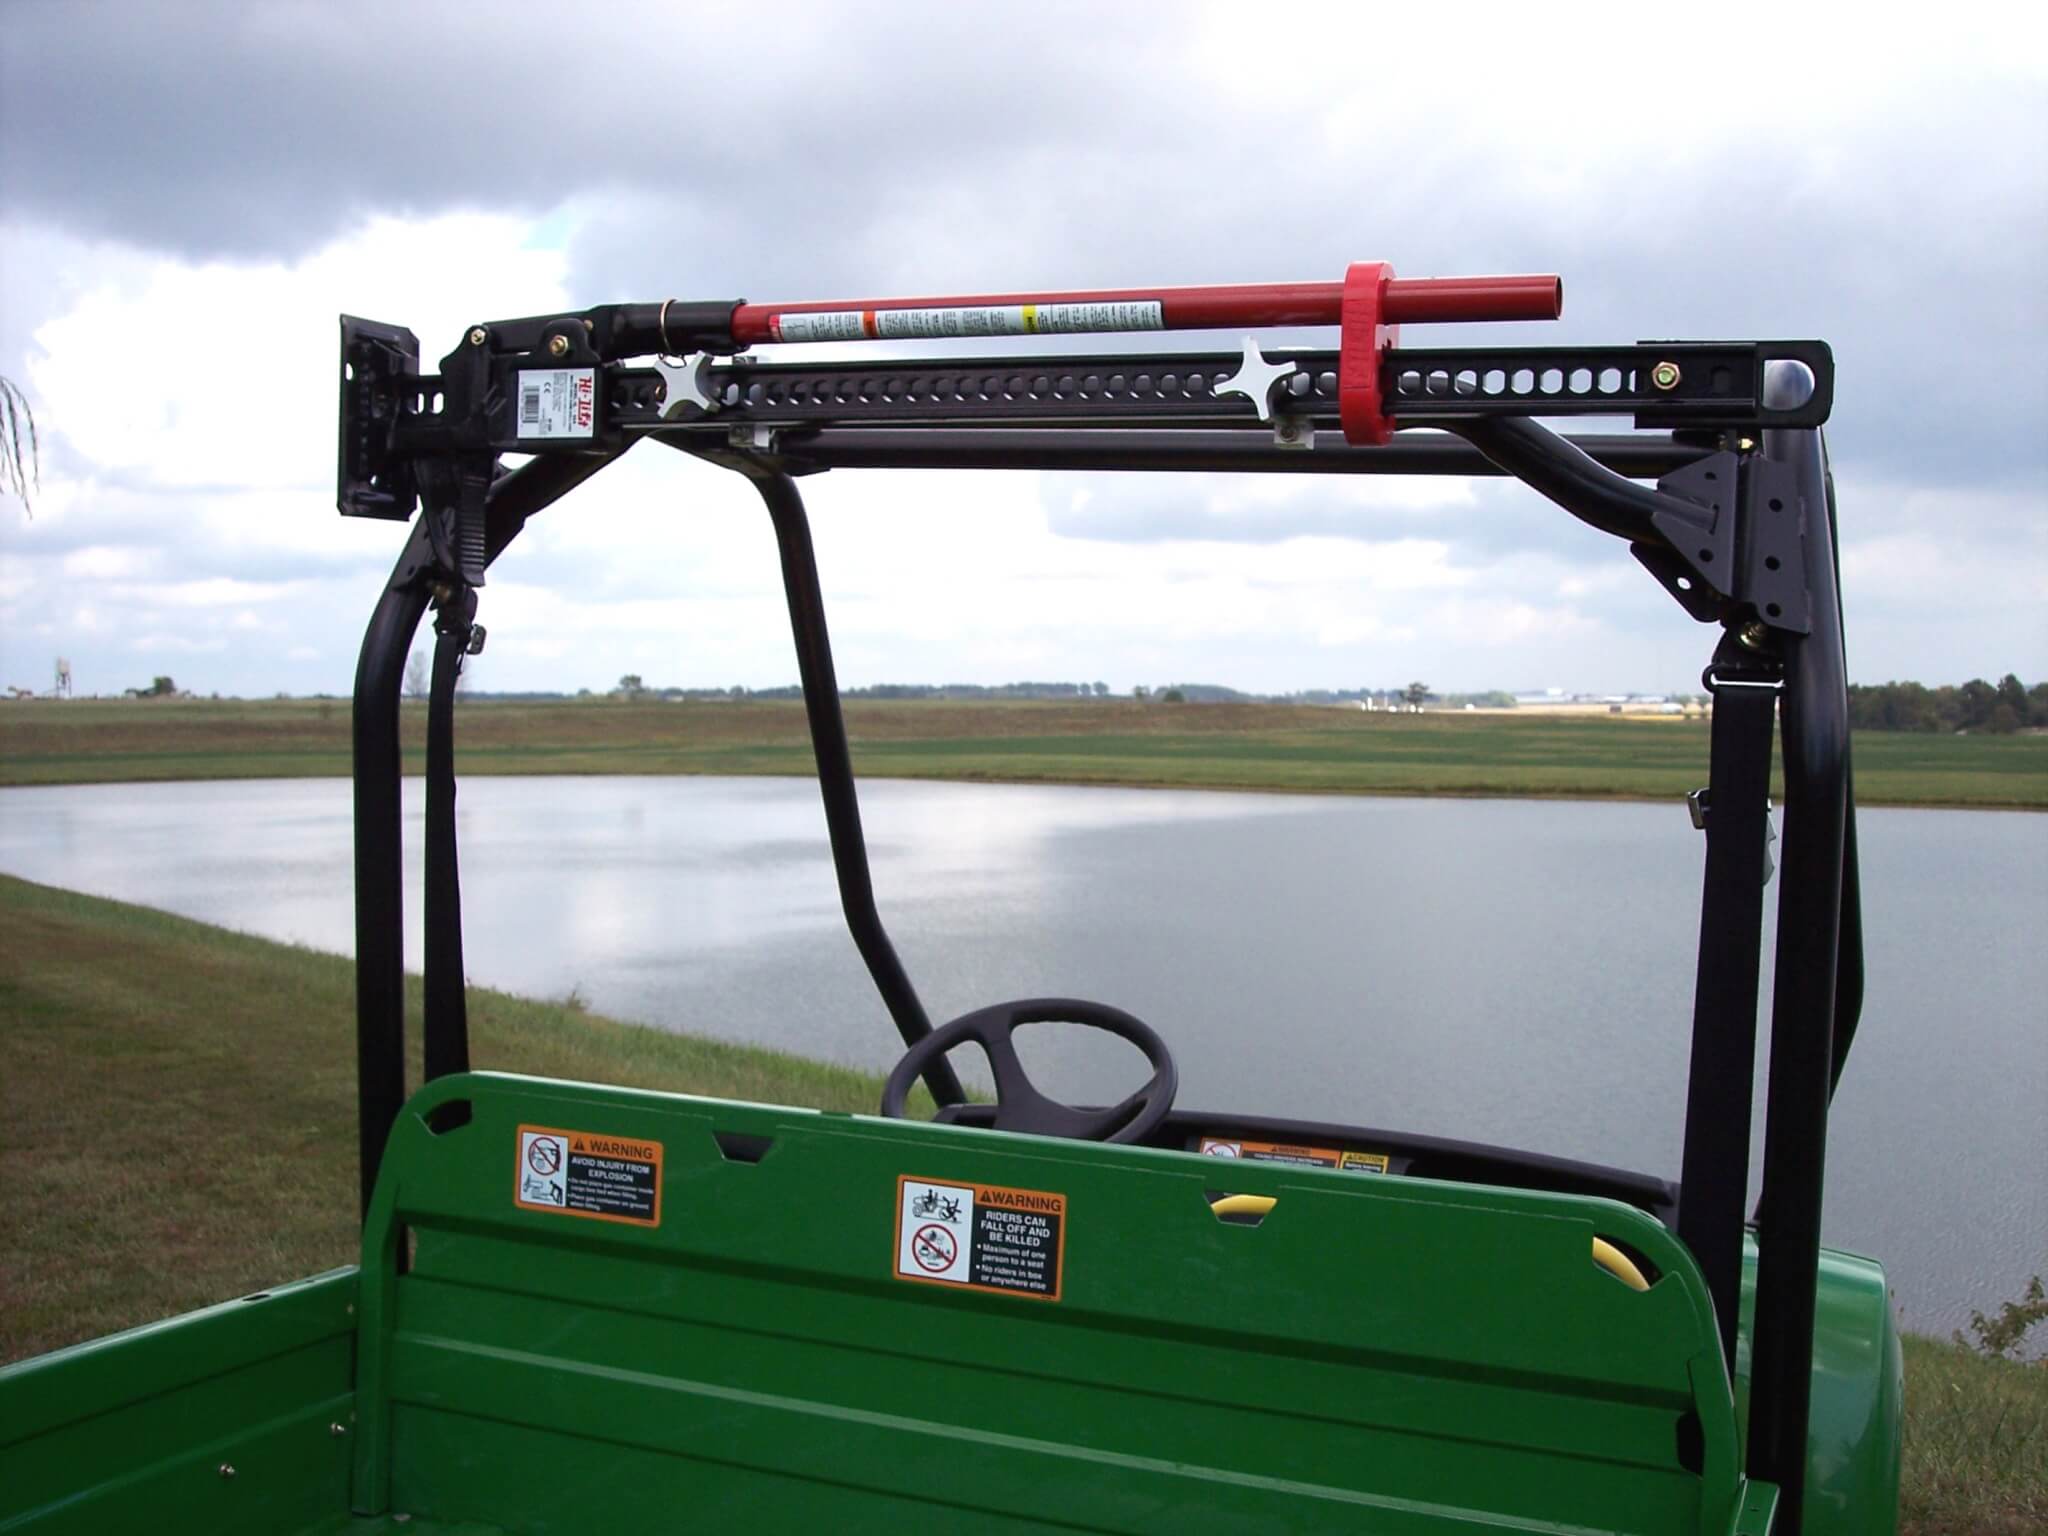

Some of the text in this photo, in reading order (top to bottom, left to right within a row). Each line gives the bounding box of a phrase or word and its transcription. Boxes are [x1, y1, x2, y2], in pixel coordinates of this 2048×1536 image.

[578, 376, 592, 428] Hi-Lift
[590, 1139, 653, 1159] WARNING
[572, 1156, 650, 1174] AVOID INJURY FROM
[588, 1169, 634, 1182] EXPLOSION
[993, 1191, 1061, 1211] WARNING
[986, 1211, 1046, 1227] RIDERS CAN
[981, 1220, 1050, 1238] FALL OFF AND
[989, 1232, 1040, 1247] BE KILLED
[983, 1243, 1020, 1256] Maximum
[1021, 1249, 1030, 1257] of
[982, 1254, 1009, 1264] person
[1011, 1257, 1019, 1265] to
[1027, 1260, 1044, 1269] seat
[981, 1264, 993, 1273] No
[994, 1267, 1017, 1277] riders
[991, 1276, 1028, 1287] anywhere
[1029, 1281, 1047, 1290] else
